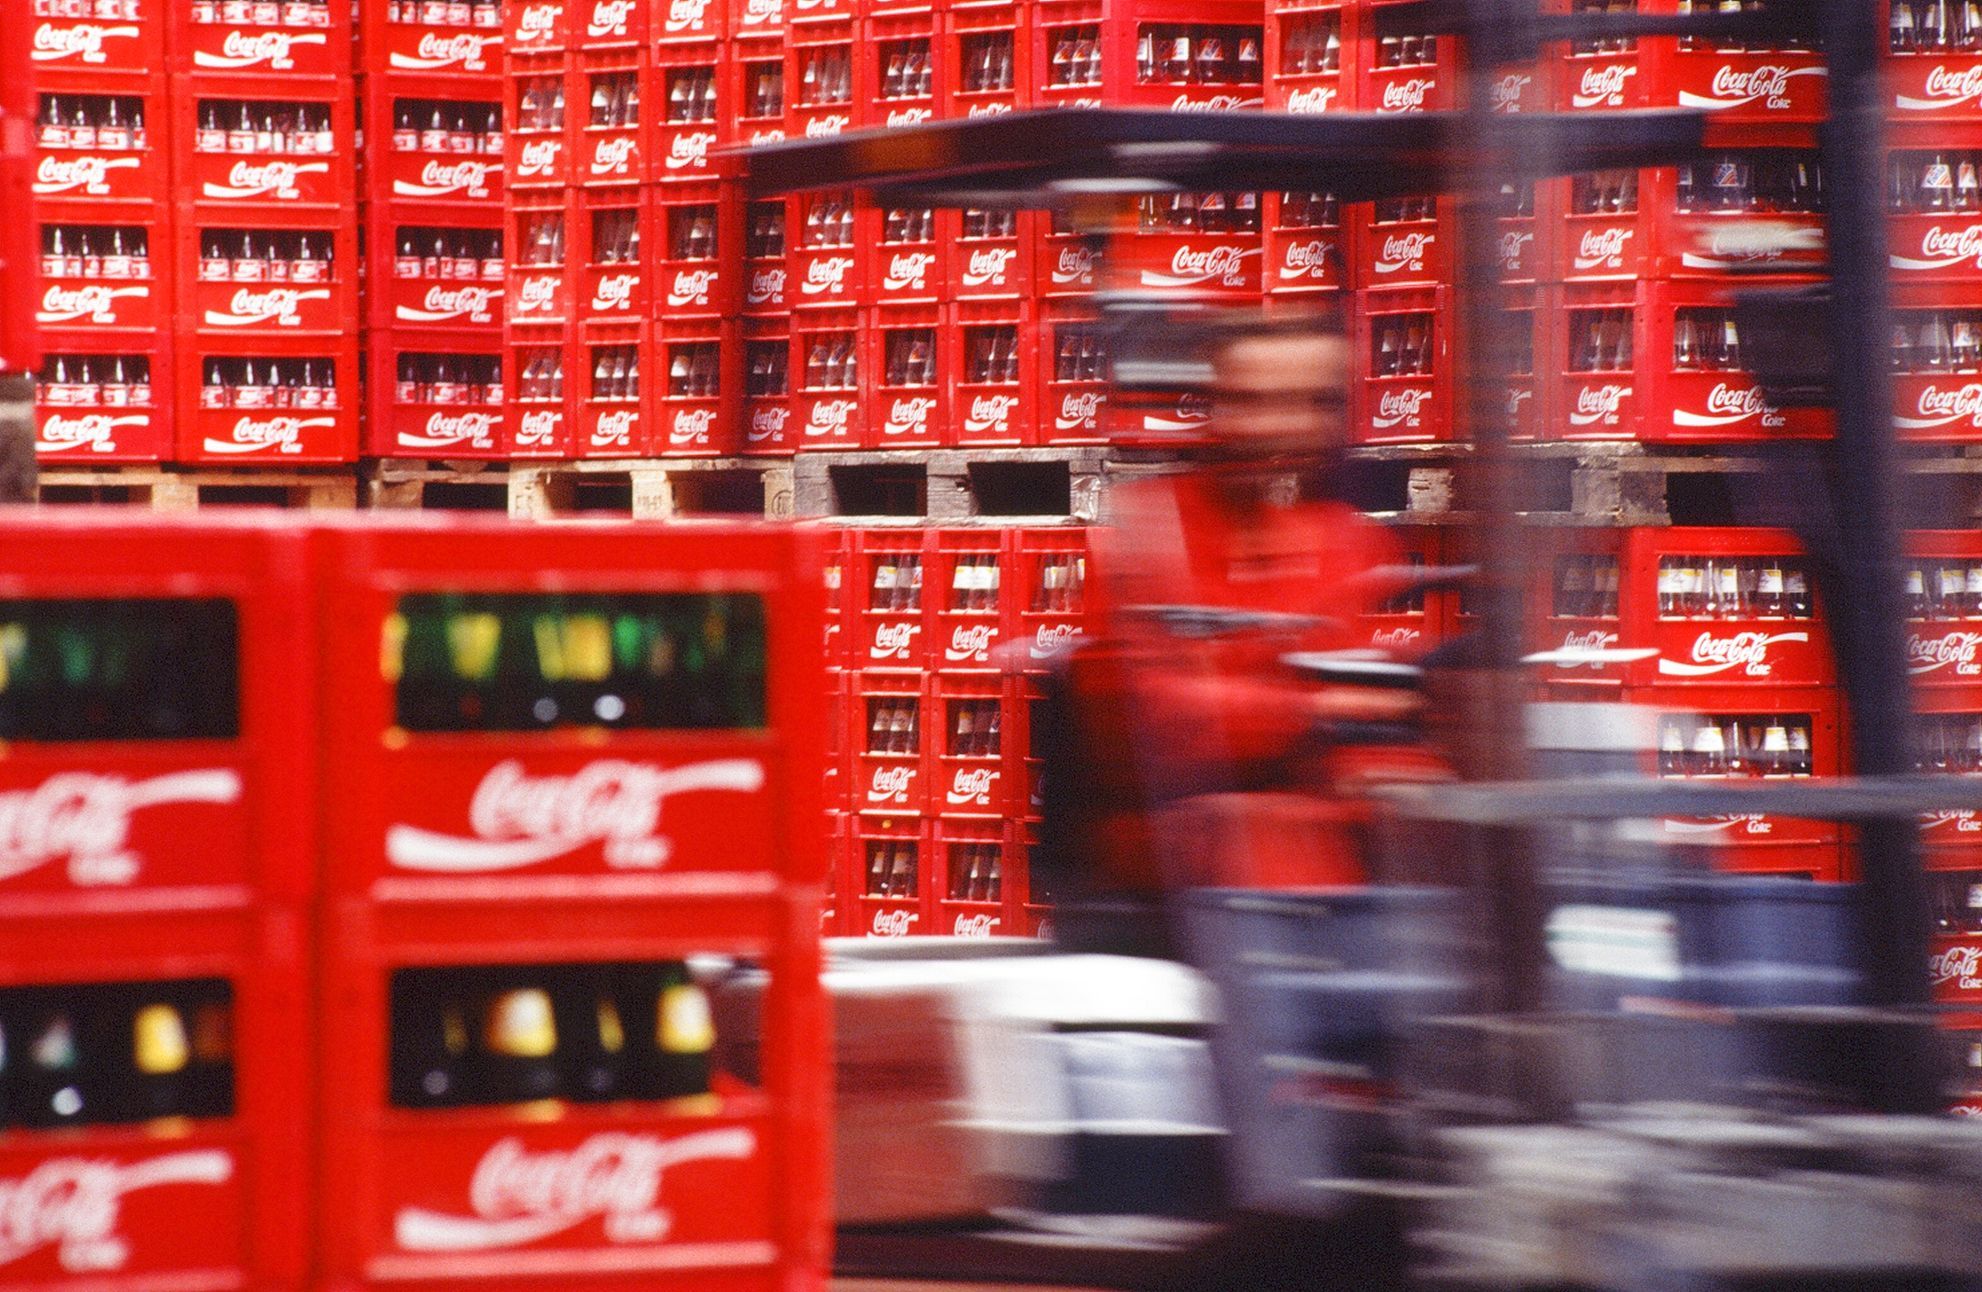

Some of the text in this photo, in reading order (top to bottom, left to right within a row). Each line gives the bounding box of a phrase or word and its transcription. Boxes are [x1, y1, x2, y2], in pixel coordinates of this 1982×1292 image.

[1581, 65, 1636, 93] Coca-Cola
[1926, 64, 1982, 96] Coca-Co
[1384, 80, 1435, 107] Coca-Cola
[1766, 95, 1791, 109] Coke
[1384, 234, 1435, 261] Coca-Cola
[1581, 229, 1633, 257] Coca-Cola
[1380, 390, 1431, 416] Coca-Cola
[1578, 385, 1632, 413] Coca-Cola
